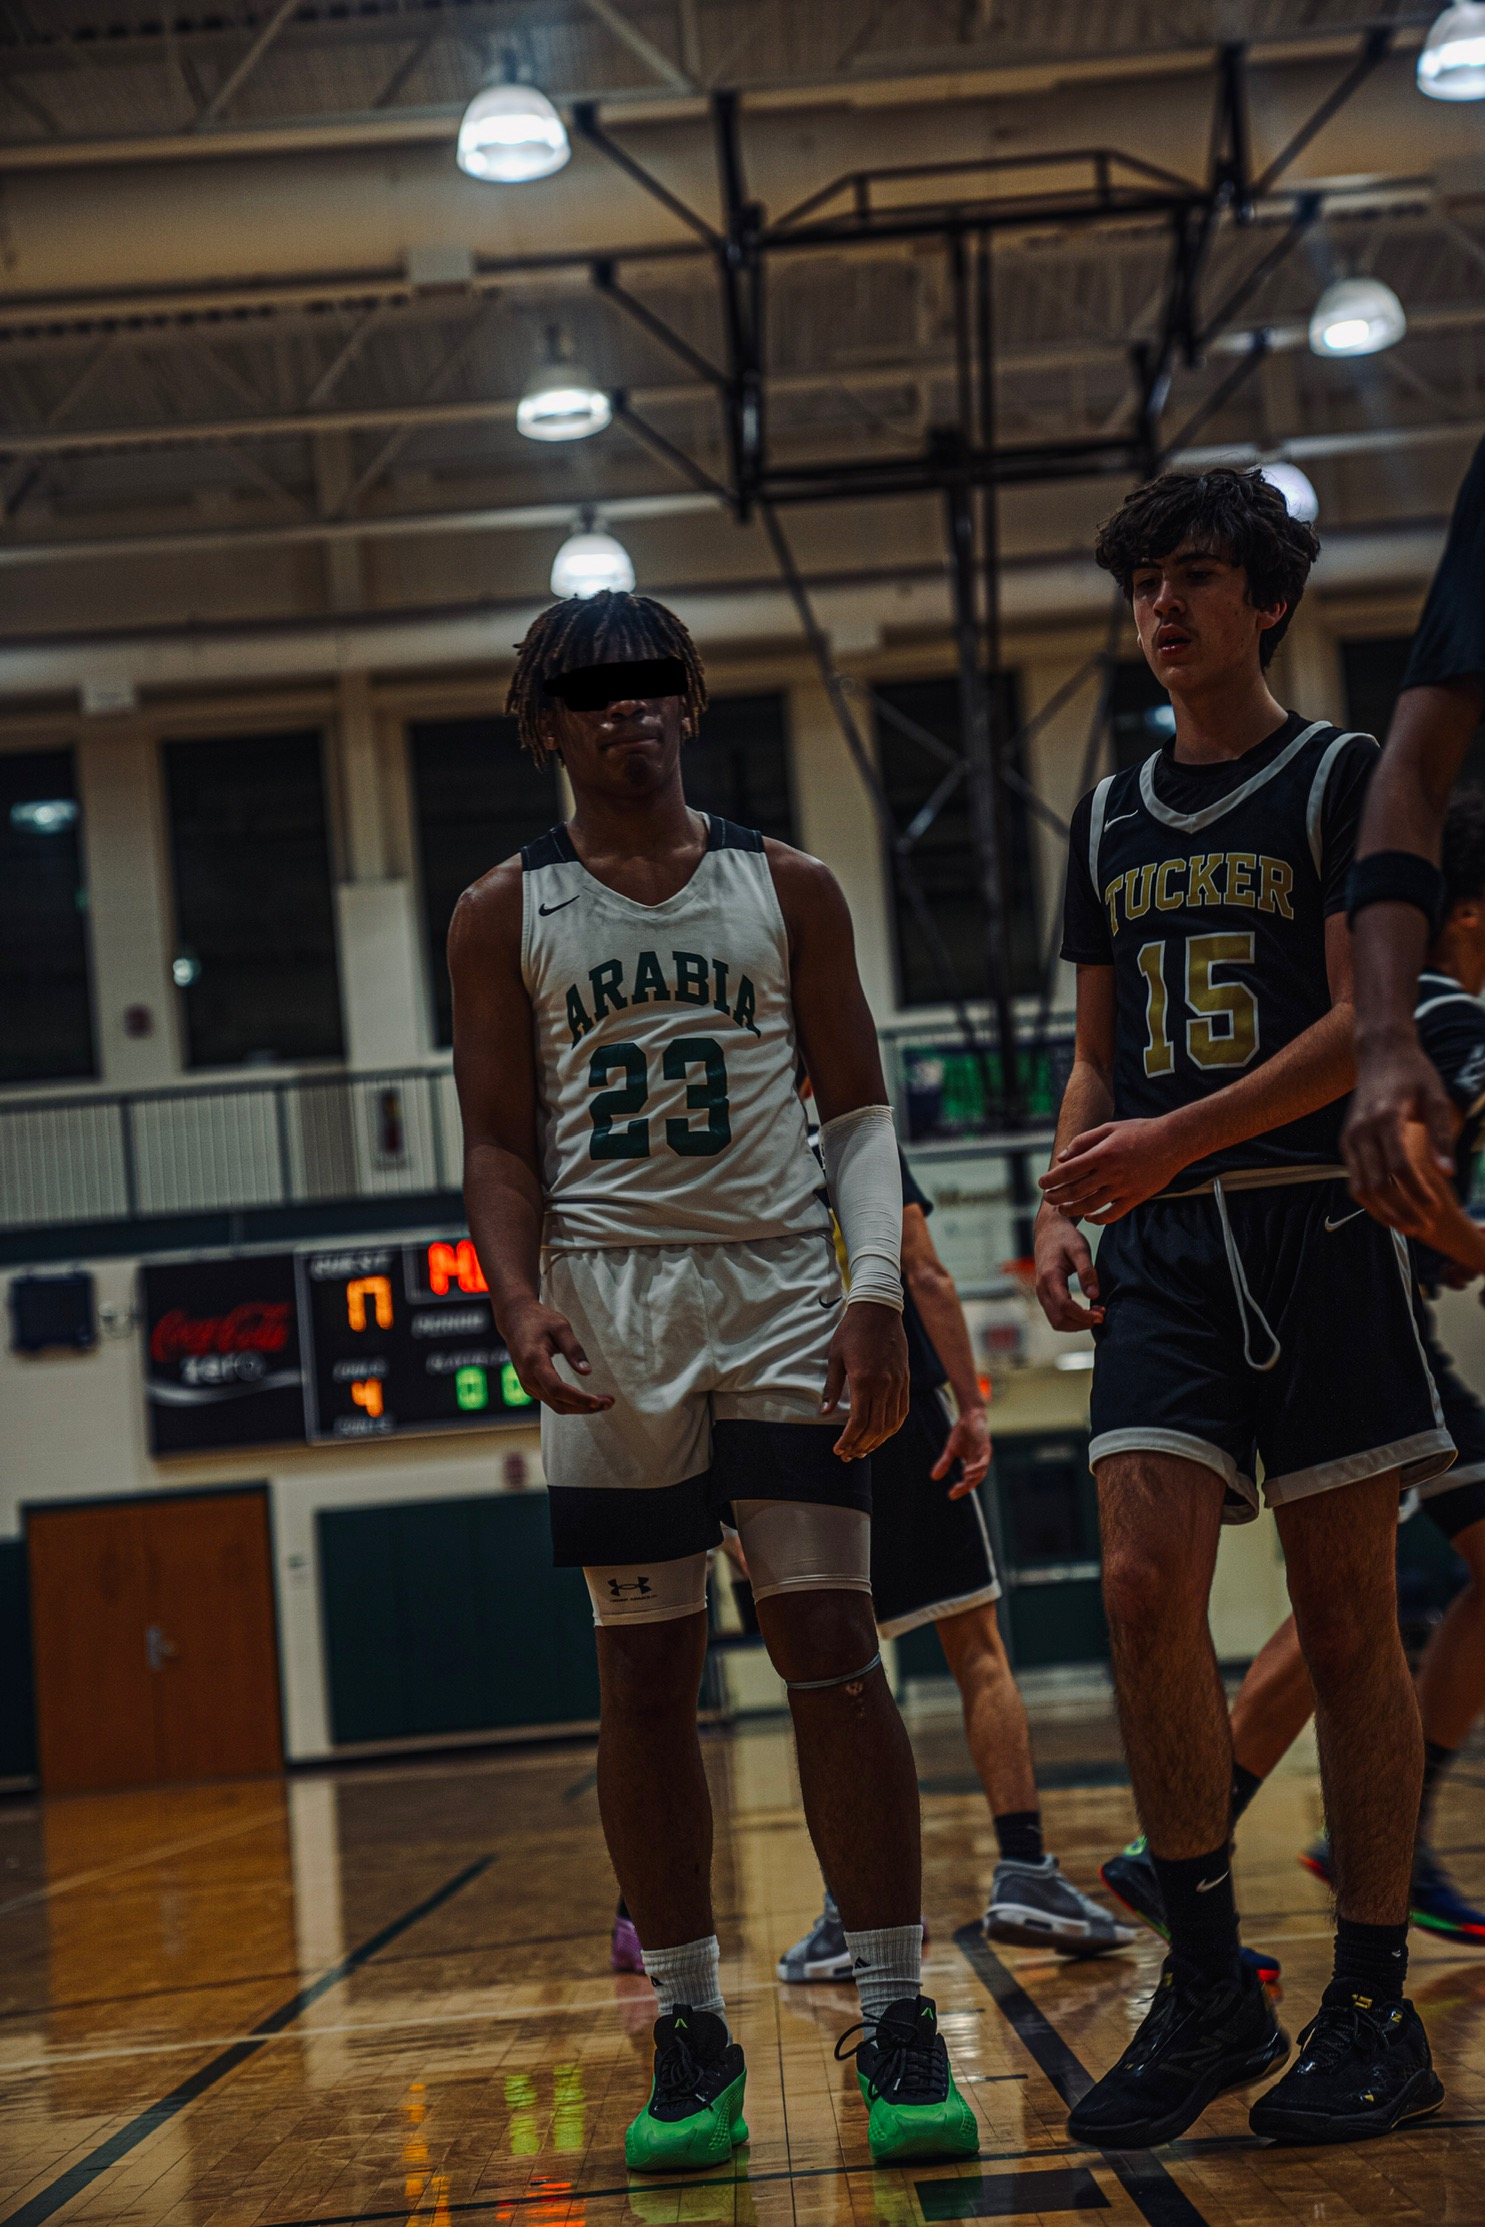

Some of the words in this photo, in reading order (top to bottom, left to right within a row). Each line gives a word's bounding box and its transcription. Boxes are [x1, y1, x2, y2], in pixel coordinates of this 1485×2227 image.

[1104, 852, 1295, 937] TUCKER
[565, 951, 762, 1050] ARABIA
[1137, 931, 1261, 1079] 15
[588, 1037, 732, 1160] 23
